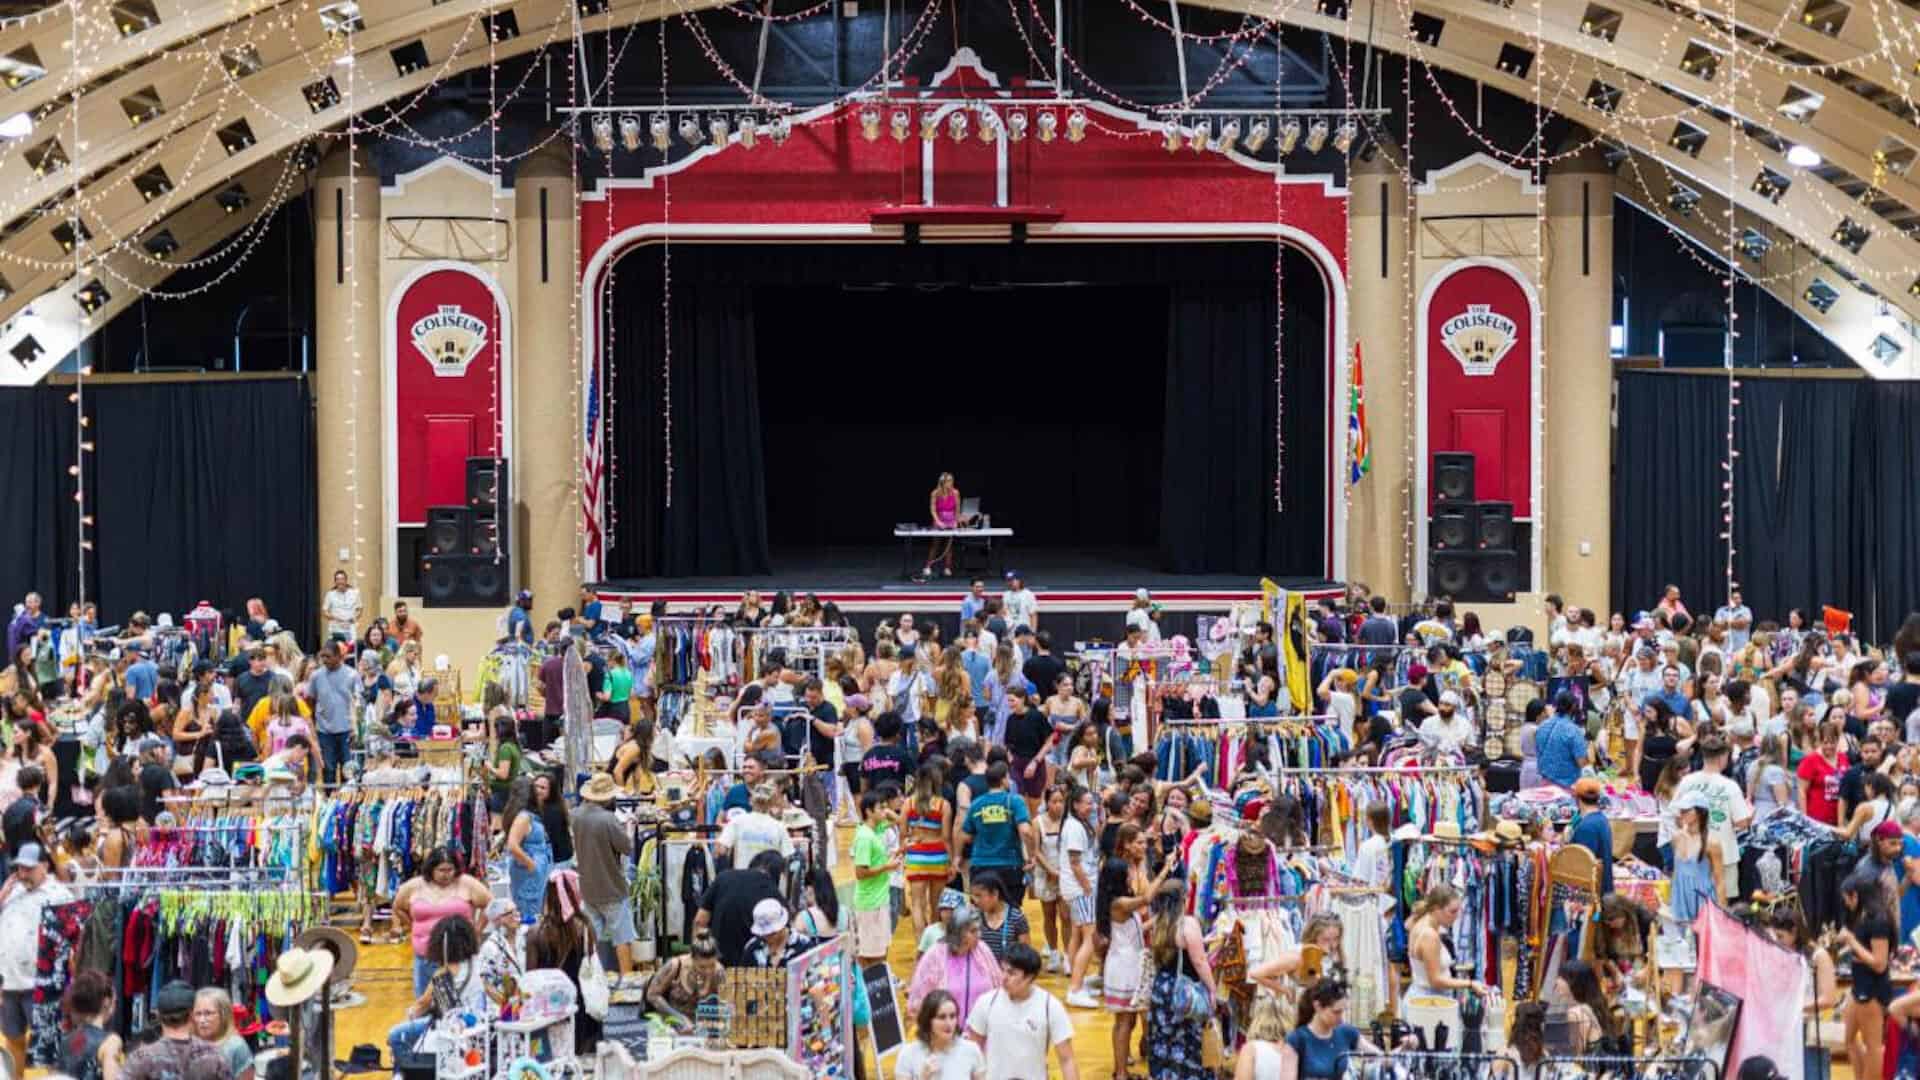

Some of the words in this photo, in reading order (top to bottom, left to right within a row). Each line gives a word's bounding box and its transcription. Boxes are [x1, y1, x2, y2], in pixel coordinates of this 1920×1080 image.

[442, 306, 456, 314] THE
[1472, 306, 1486, 314] THE
[415, 315, 485, 337] COLISEUM
[1445, 314, 1513, 336] COLISEUM
